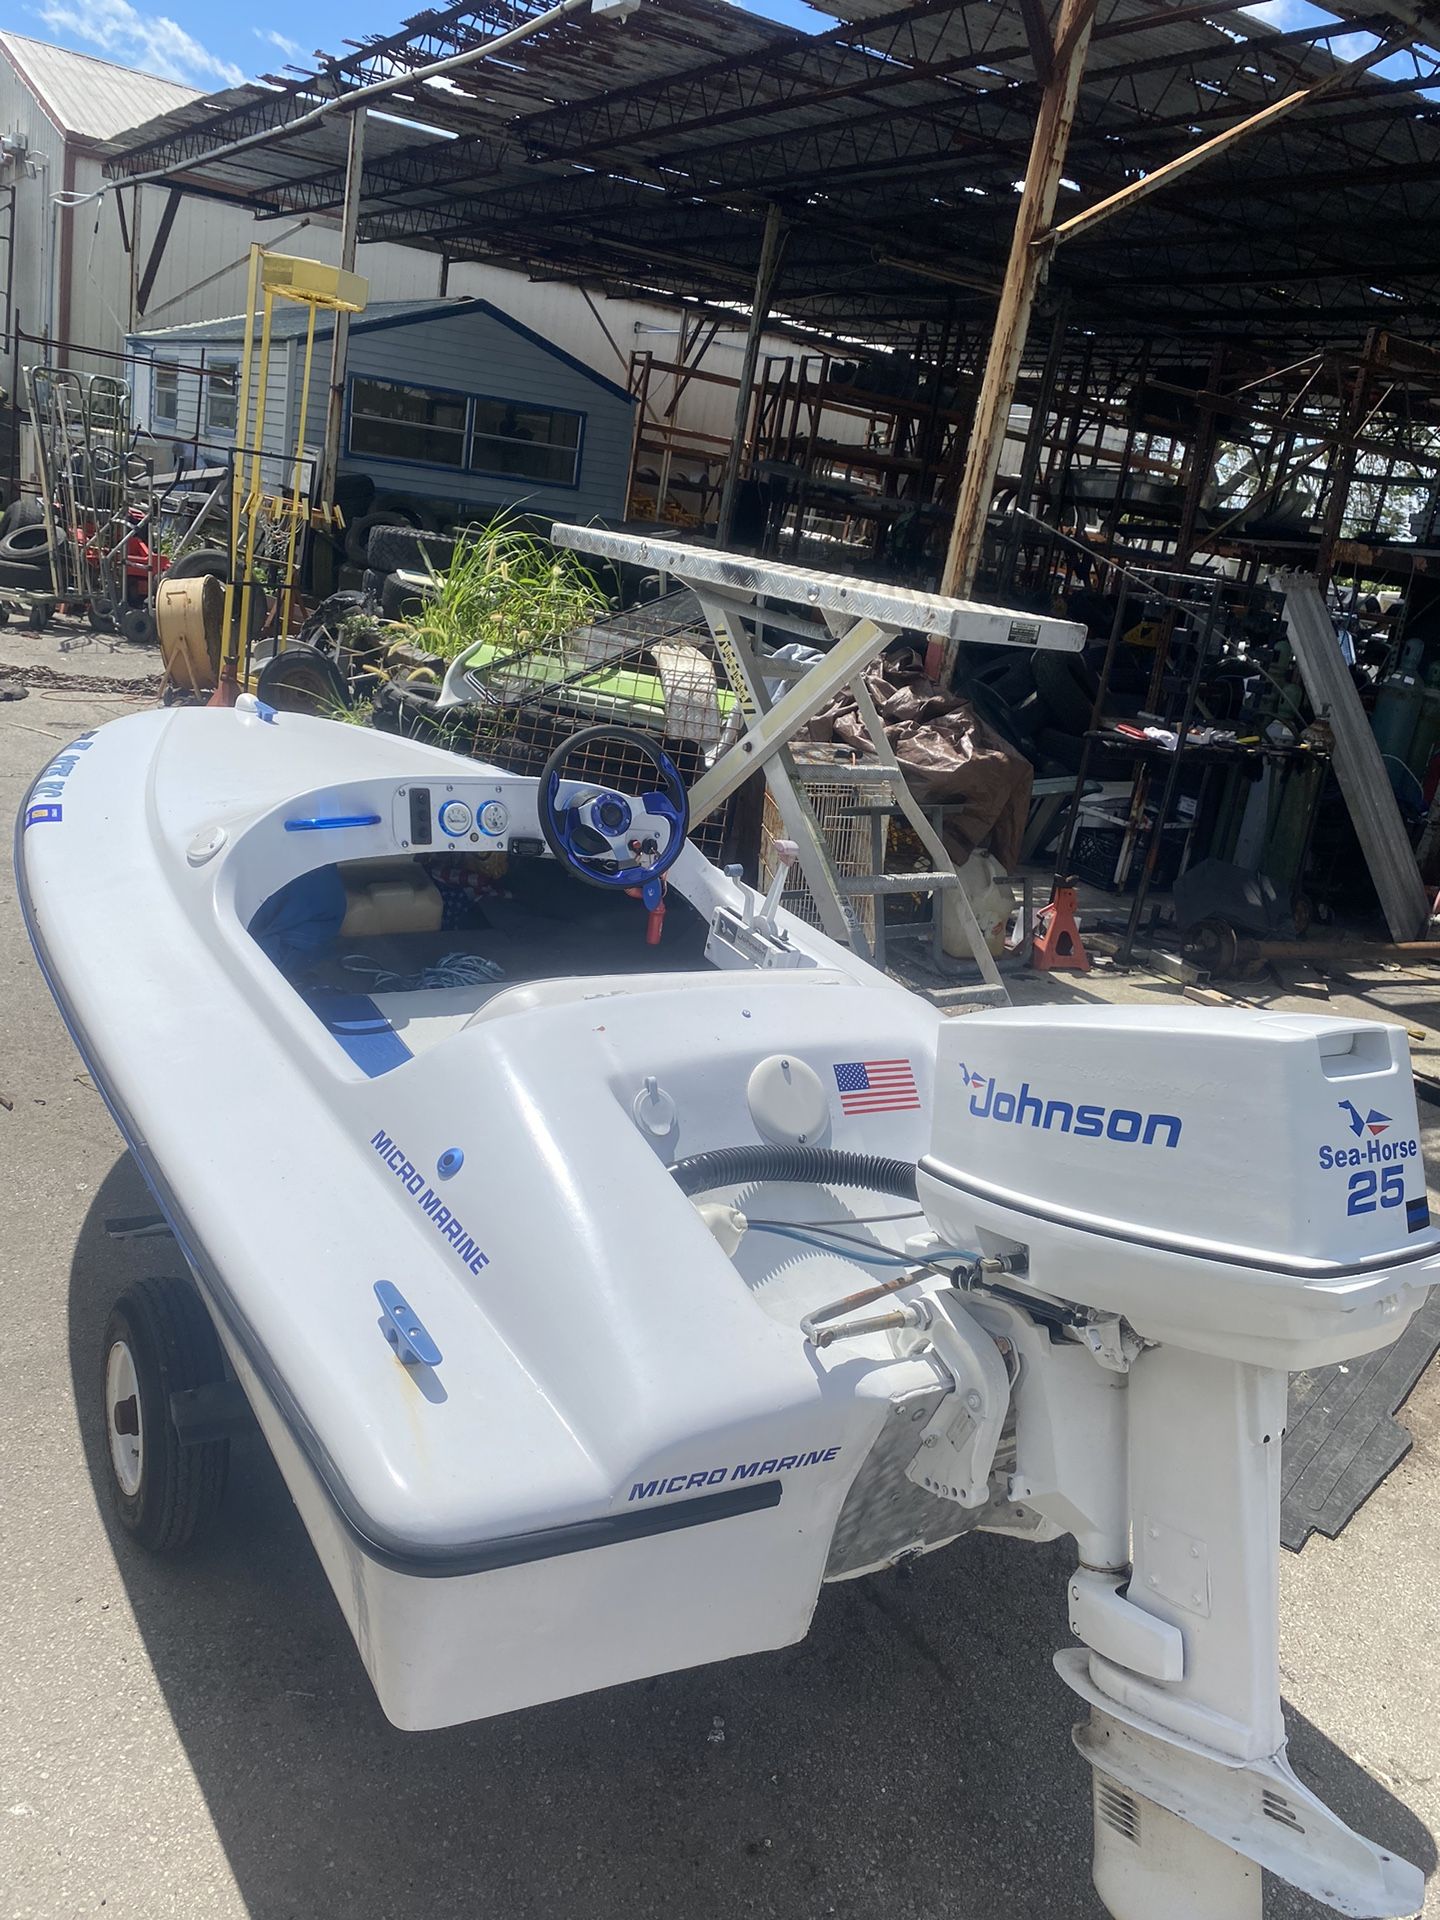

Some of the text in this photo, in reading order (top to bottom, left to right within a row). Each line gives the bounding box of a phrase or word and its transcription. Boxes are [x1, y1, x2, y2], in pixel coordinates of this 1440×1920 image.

[969, 1078, 1183, 1148] Johnson
[1319, 1138, 1418, 1170] Sea-Horse
[370, 1129, 490, 1276] MICRO MARINE
[1347, 1164, 1405, 1216] 25
[628, 1446, 842, 1501] MICRO MARINE
